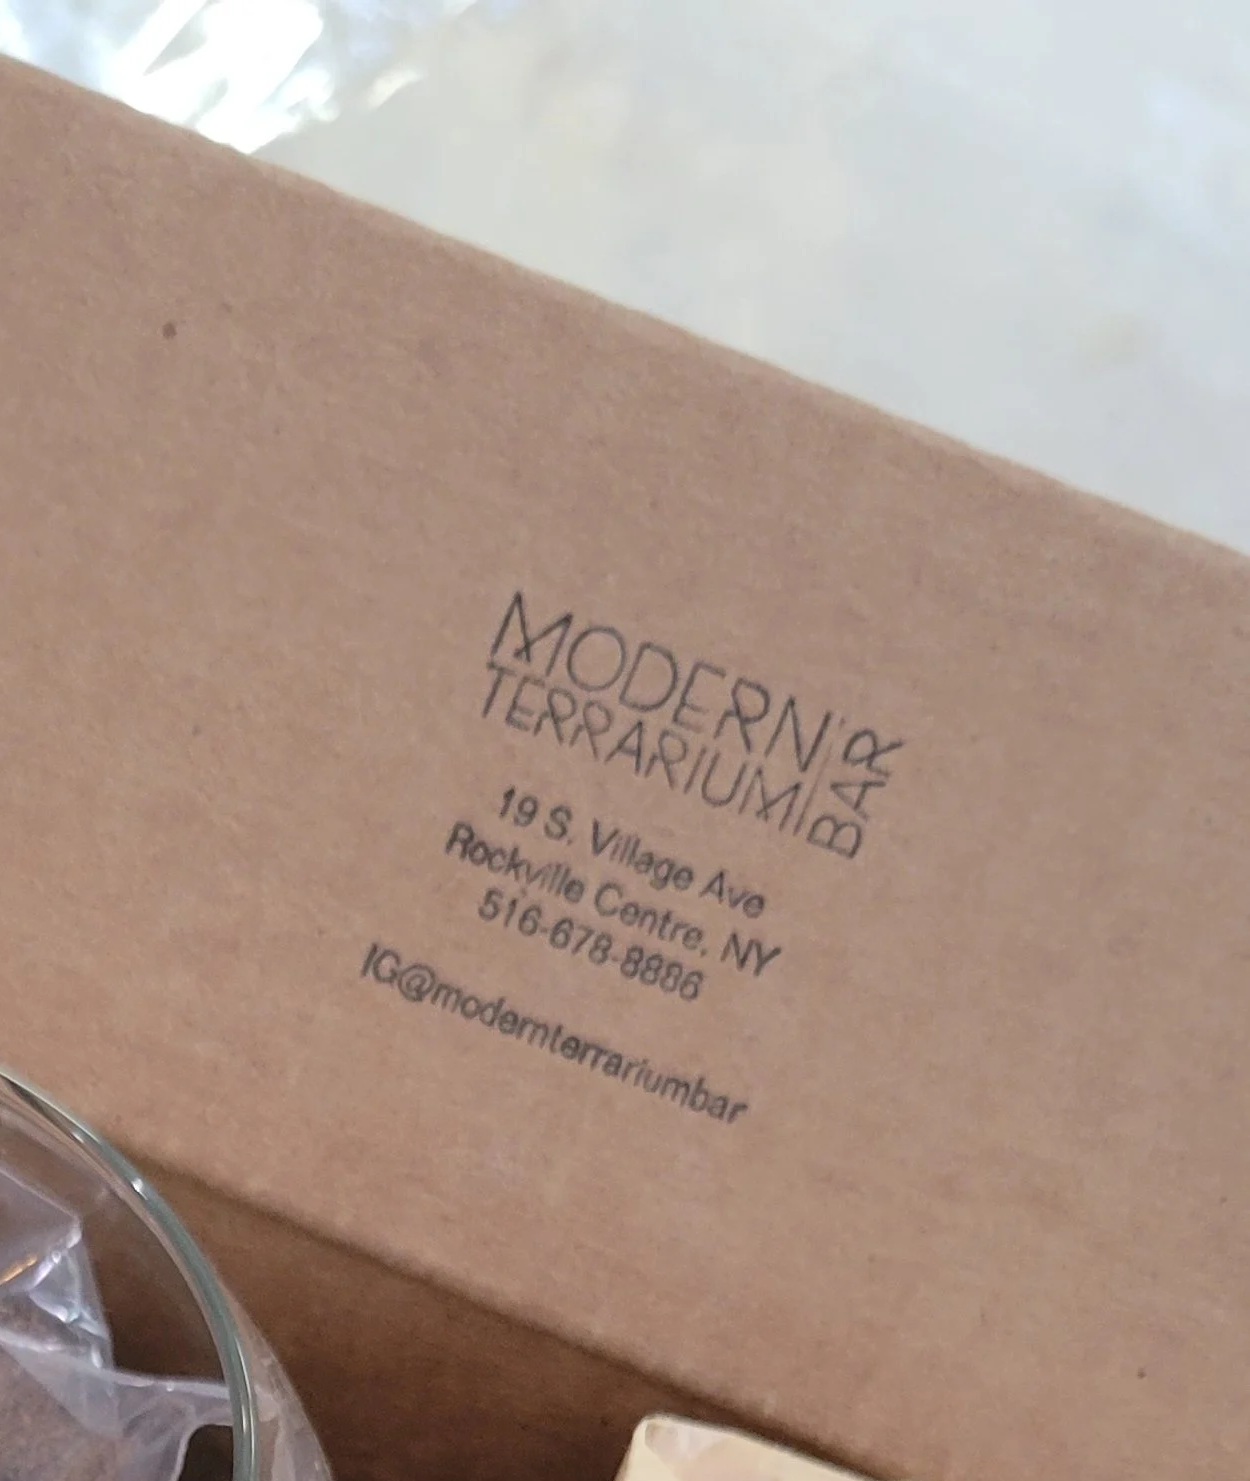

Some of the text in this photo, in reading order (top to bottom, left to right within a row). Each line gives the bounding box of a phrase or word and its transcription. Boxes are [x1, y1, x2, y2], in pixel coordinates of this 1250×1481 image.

[480, 659, 805, 832] TERRARIUM
[490, 591, 833, 773] MODERN
[498, 784, 766, 920] 19 S. Village Ave
[805, 727, 906, 860] BAR
[444, 820, 783, 978] Rockville Centre, NY
[477, 887, 704, 1002] 516-678-8886
[360, 942, 749, 1124] IG@modernterrariumbar
